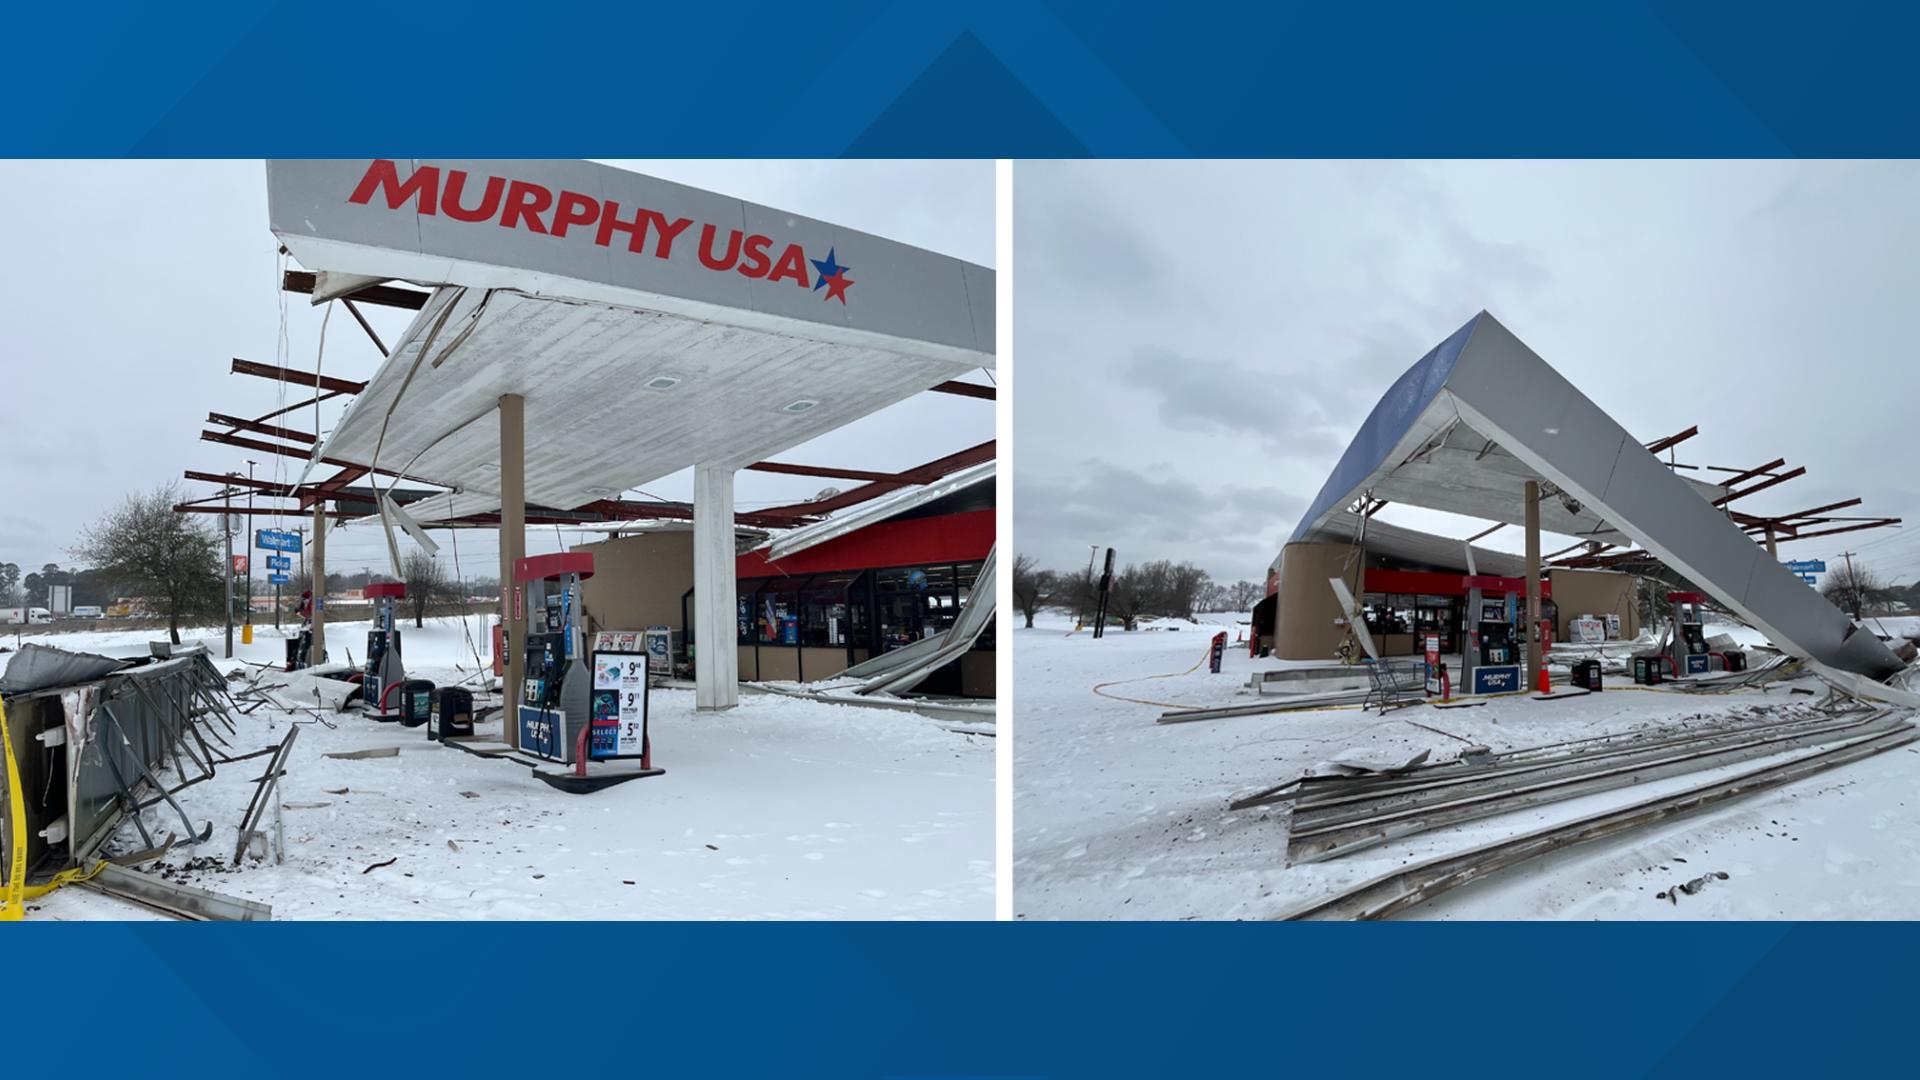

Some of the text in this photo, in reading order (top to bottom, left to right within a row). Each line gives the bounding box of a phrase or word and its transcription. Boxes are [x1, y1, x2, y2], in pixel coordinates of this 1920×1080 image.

[348, 159, 811, 289] MURPHY USA
[592, 728, 617, 736] SELECT
